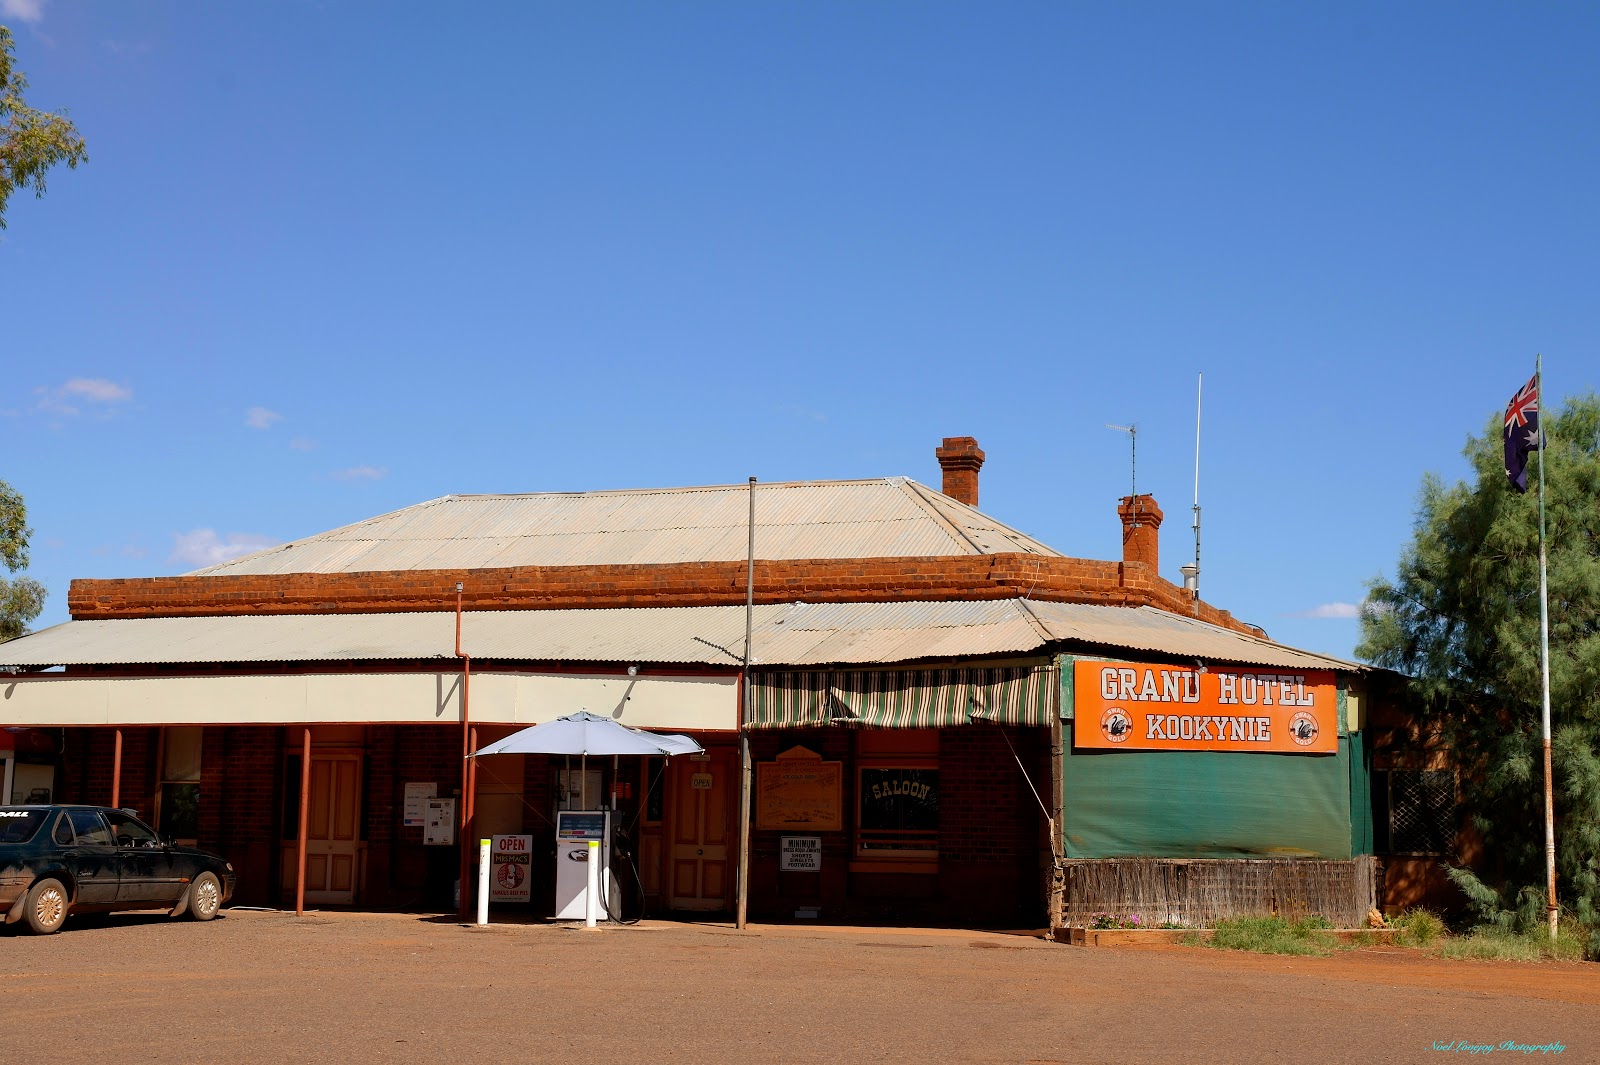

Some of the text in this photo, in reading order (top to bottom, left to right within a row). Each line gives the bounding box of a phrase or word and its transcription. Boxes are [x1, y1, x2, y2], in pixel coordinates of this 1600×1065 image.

[1101, 667, 1314, 706] GRAND HOTEL
[1106, 707, 1126, 716] SWAN
[1294, 712, 1313, 720] SWAN
[1146, 714, 1271, 742] KOOKYNIE
[1107, 734, 1126, 742] GOLD
[1295, 737, 1312, 745] GOLD
[693, 778, 710, 787] OPEN
[872, 779, 930, 800] SALOON
[499, 838, 525, 851] OPEN
[788, 839, 816, 848] MINIMUM
